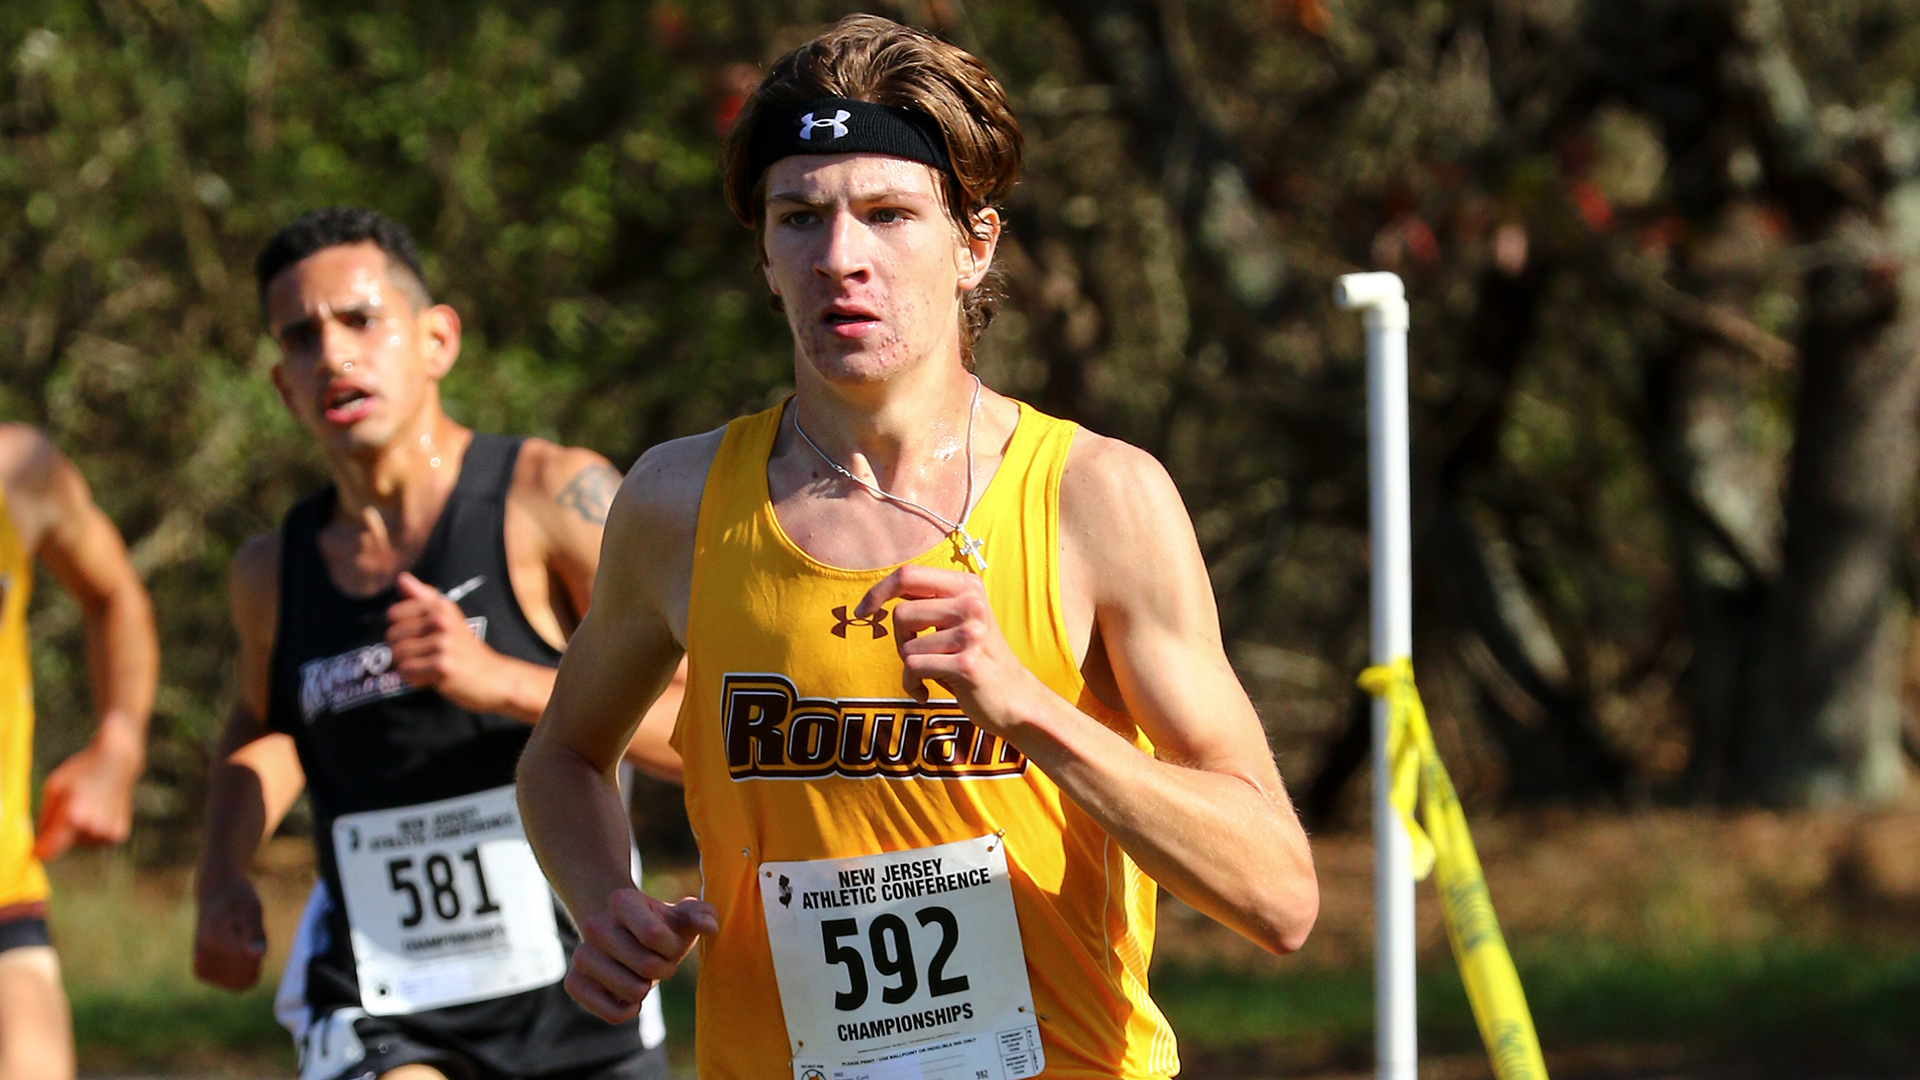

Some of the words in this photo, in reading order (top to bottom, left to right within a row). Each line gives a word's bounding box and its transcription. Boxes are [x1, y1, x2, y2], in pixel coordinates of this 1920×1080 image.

[388, 847, 500, 928] 581
[803, 886, 877, 909] ATHLETIC
[881, 868, 991, 901] CONFERENCE
[838, 868, 875, 888] NEW
[881, 858, 942, 883] JERSEY
[821, 906, 970, 1011] 592
[837, 1003, 974, 1042] CHAMPIONSHIPS
[975, 1069, 989, 1079] 592
